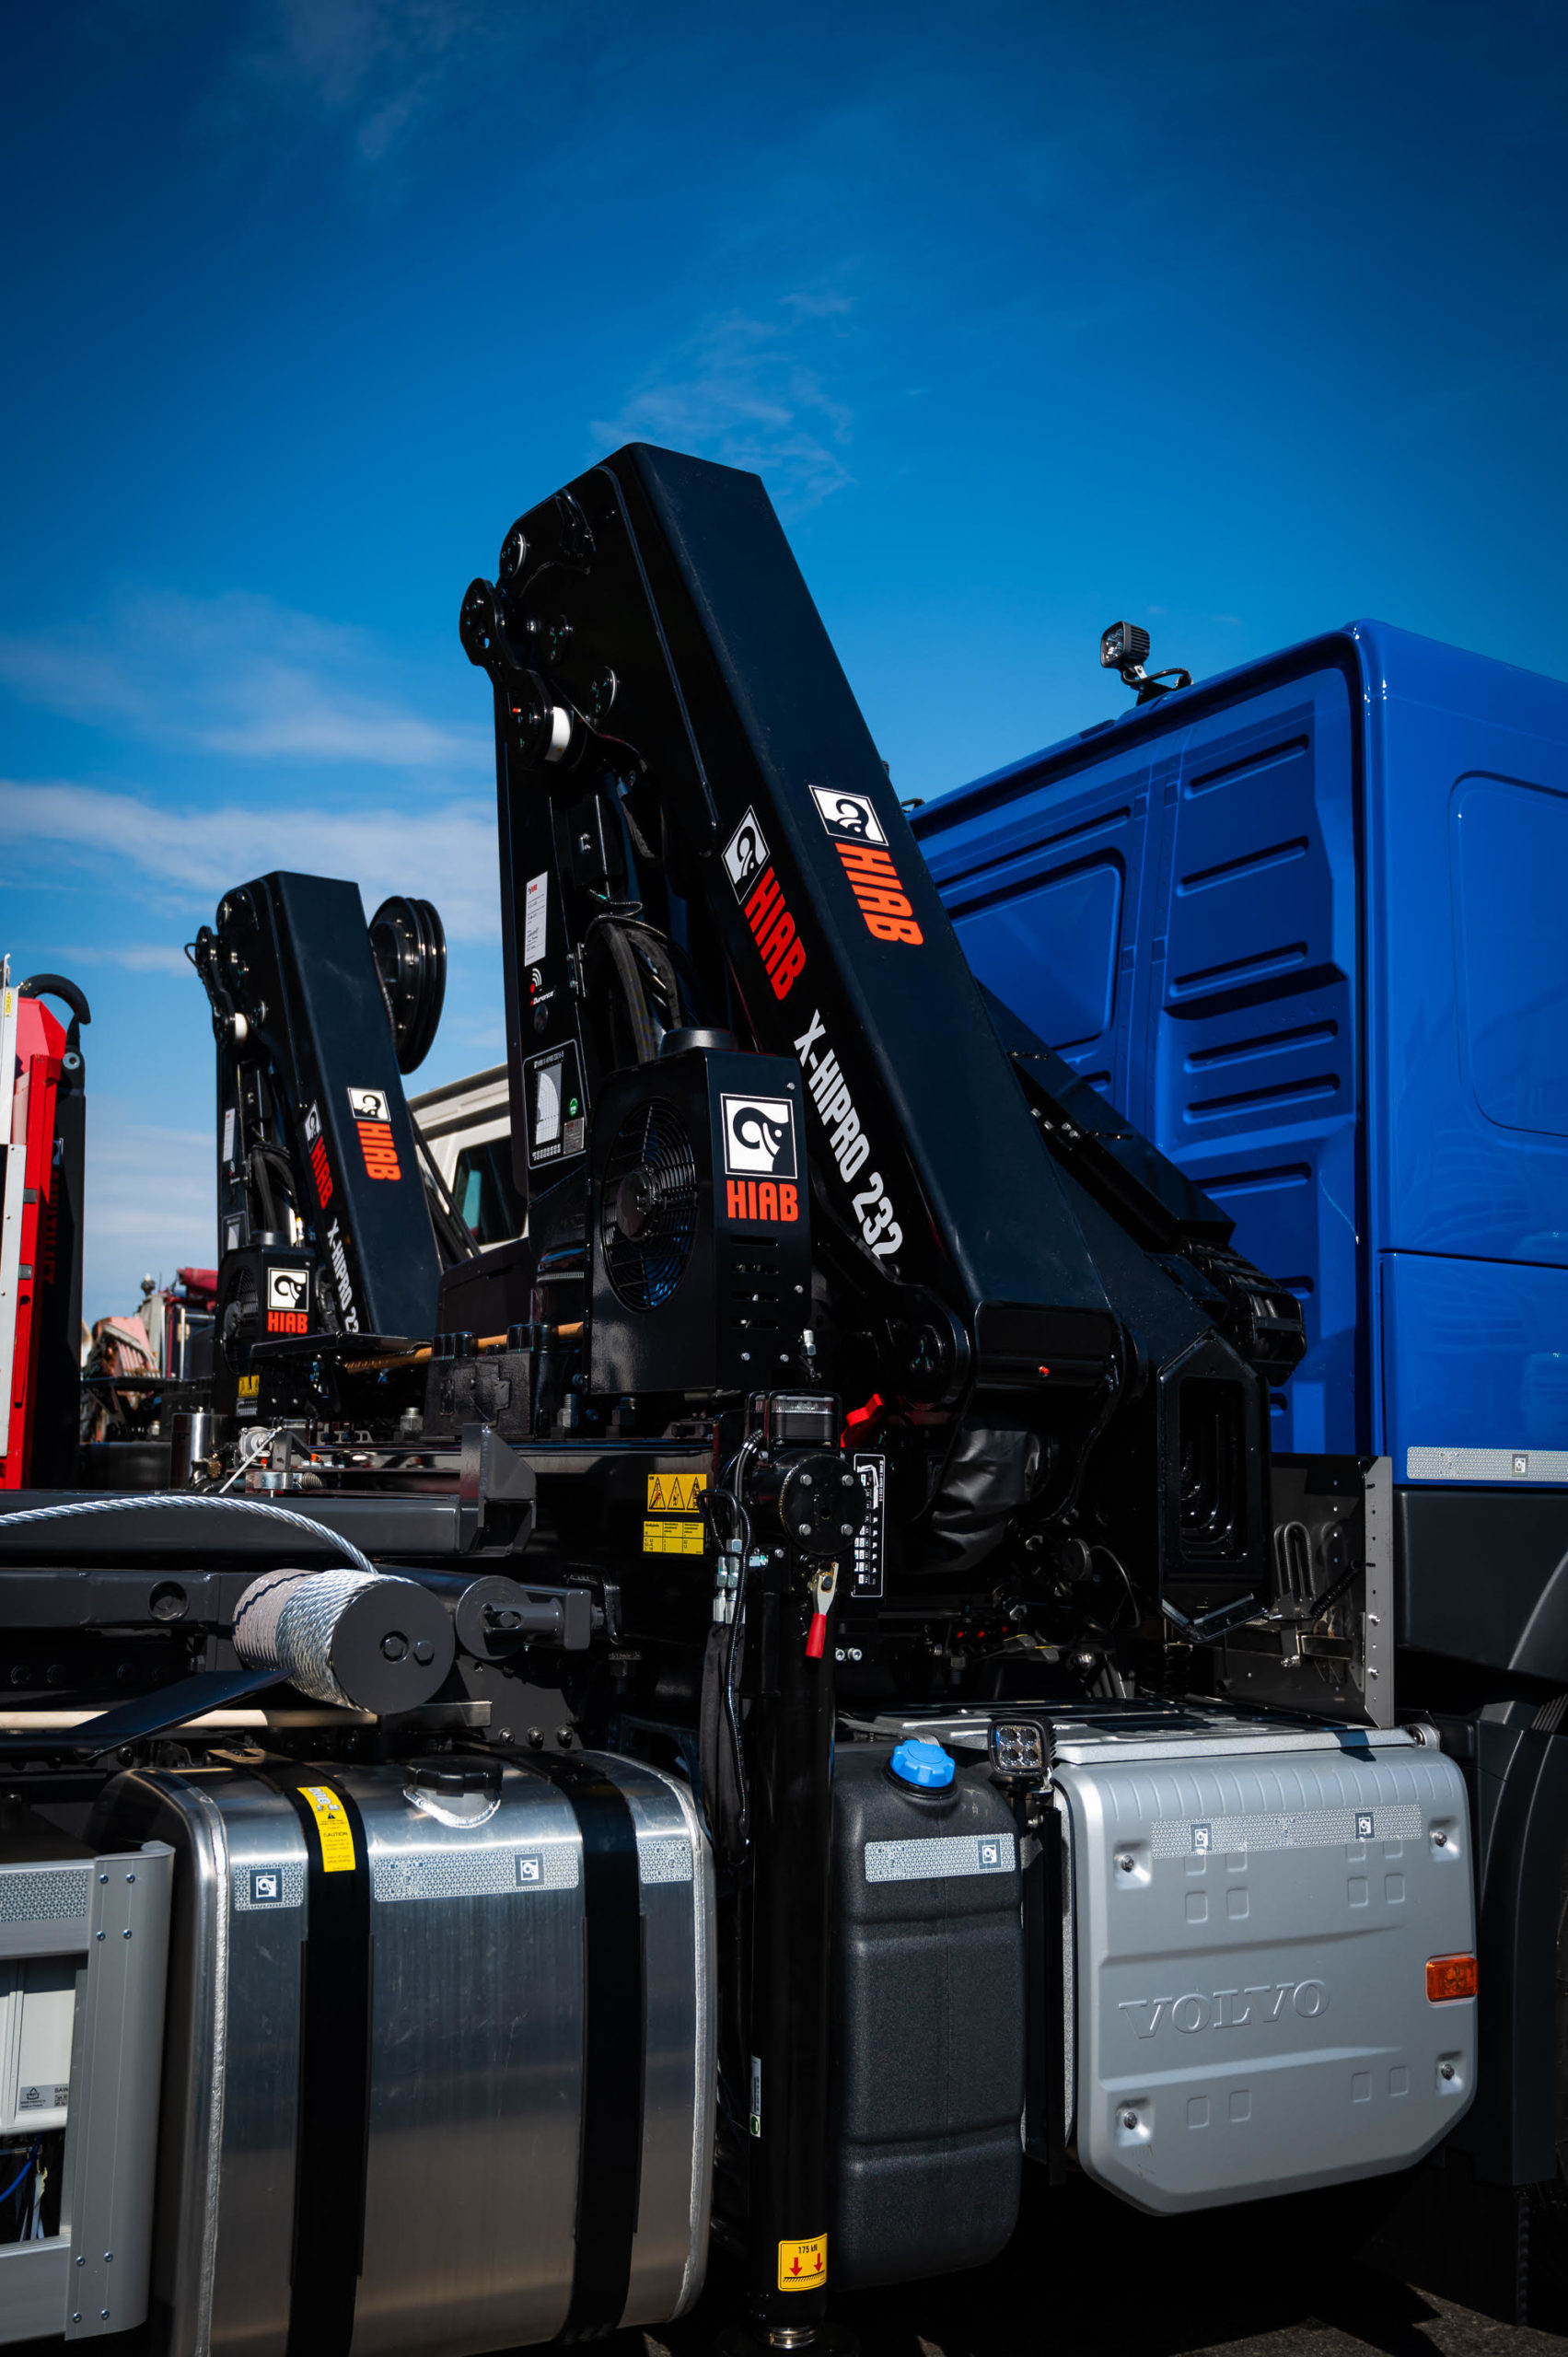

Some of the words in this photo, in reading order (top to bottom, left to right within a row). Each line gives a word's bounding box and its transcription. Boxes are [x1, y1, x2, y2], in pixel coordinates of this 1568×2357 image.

[834, 842, 923, 946] HIAB
[744, 865, 806, 1001] HIAB
[356, 1120, 401, 1181] HIAB
[793, 1008, 870, 1183] X-HIPRO
[852, 1171, 903, 1260] 232
[310, 1135, 333, 1211] HIAB
[726, 1179, 798, 1222] HIAB
[327, 1216, 353, 1311] X-HIPRO
[267, 1311, 308, 1334] HIAB
[1119, 1979, 1330, 2039] VOLVO
[798, 2246, 810, 2254] 175
[810, 2244, 819, 2252] kN
